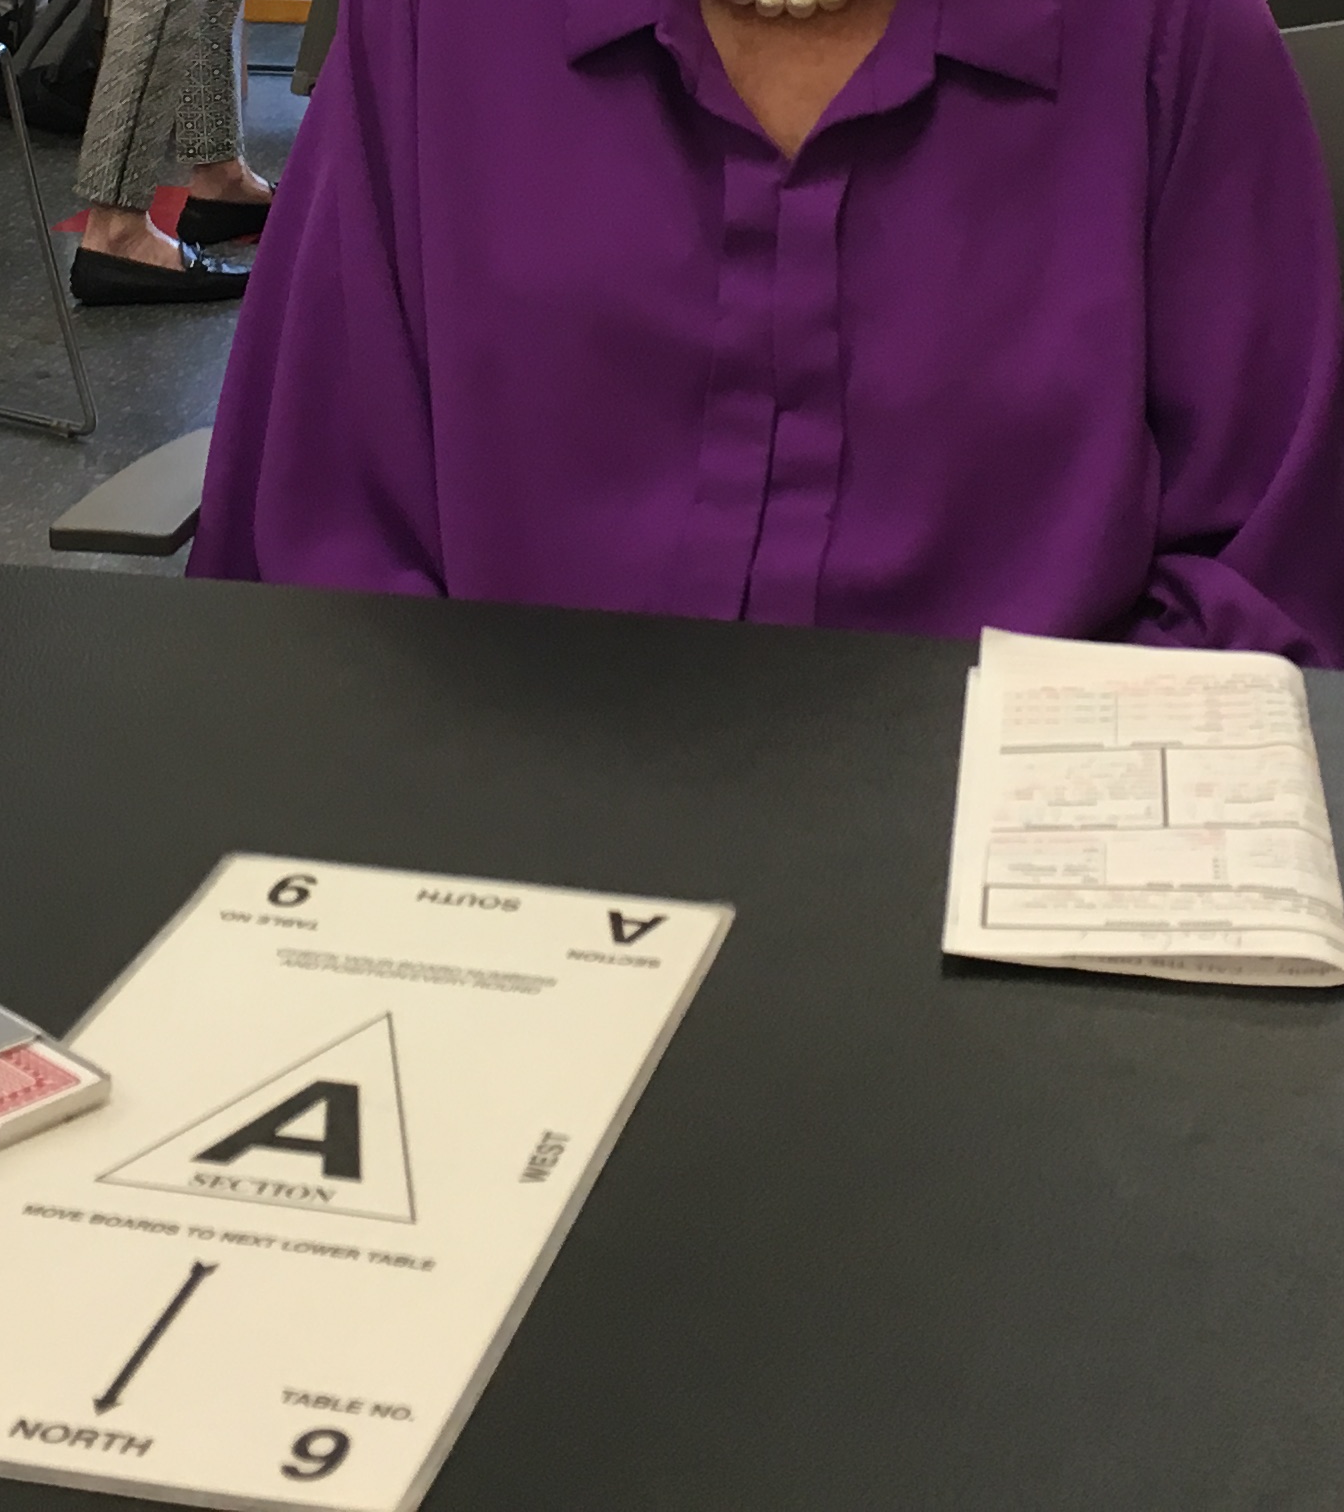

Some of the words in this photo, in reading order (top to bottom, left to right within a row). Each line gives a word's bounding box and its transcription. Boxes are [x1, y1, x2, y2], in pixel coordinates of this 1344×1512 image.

[416, 888, 522, 913] SOUTH
[257, 913, 319, 931] TABLE
[607, 909, 670, 947] A
[565, 947, 664, 970] SECTION
[189, 1079, 363, 1184] A
[518, 1127, 572, 1186] WEST
[187, 1170, 338, 1205] SECTION
[21, 1201, 86, 1225] MOVE
[88, 1212, 181, 1238] BOARDS
[186, 1226, 217, 1242] TO
[219, 1230, 279, 1251] NEXT
[281, 1239, 362, 1263] LOWER
[365, 1249, 437, 1274] TABLE
[280, 1386, 365, 1417] TABLE
[369, 1400, 416, 1423] NO.
[8, 1416, 155, 1459] NORTH
[279, 1427, 353, 1484] 9
